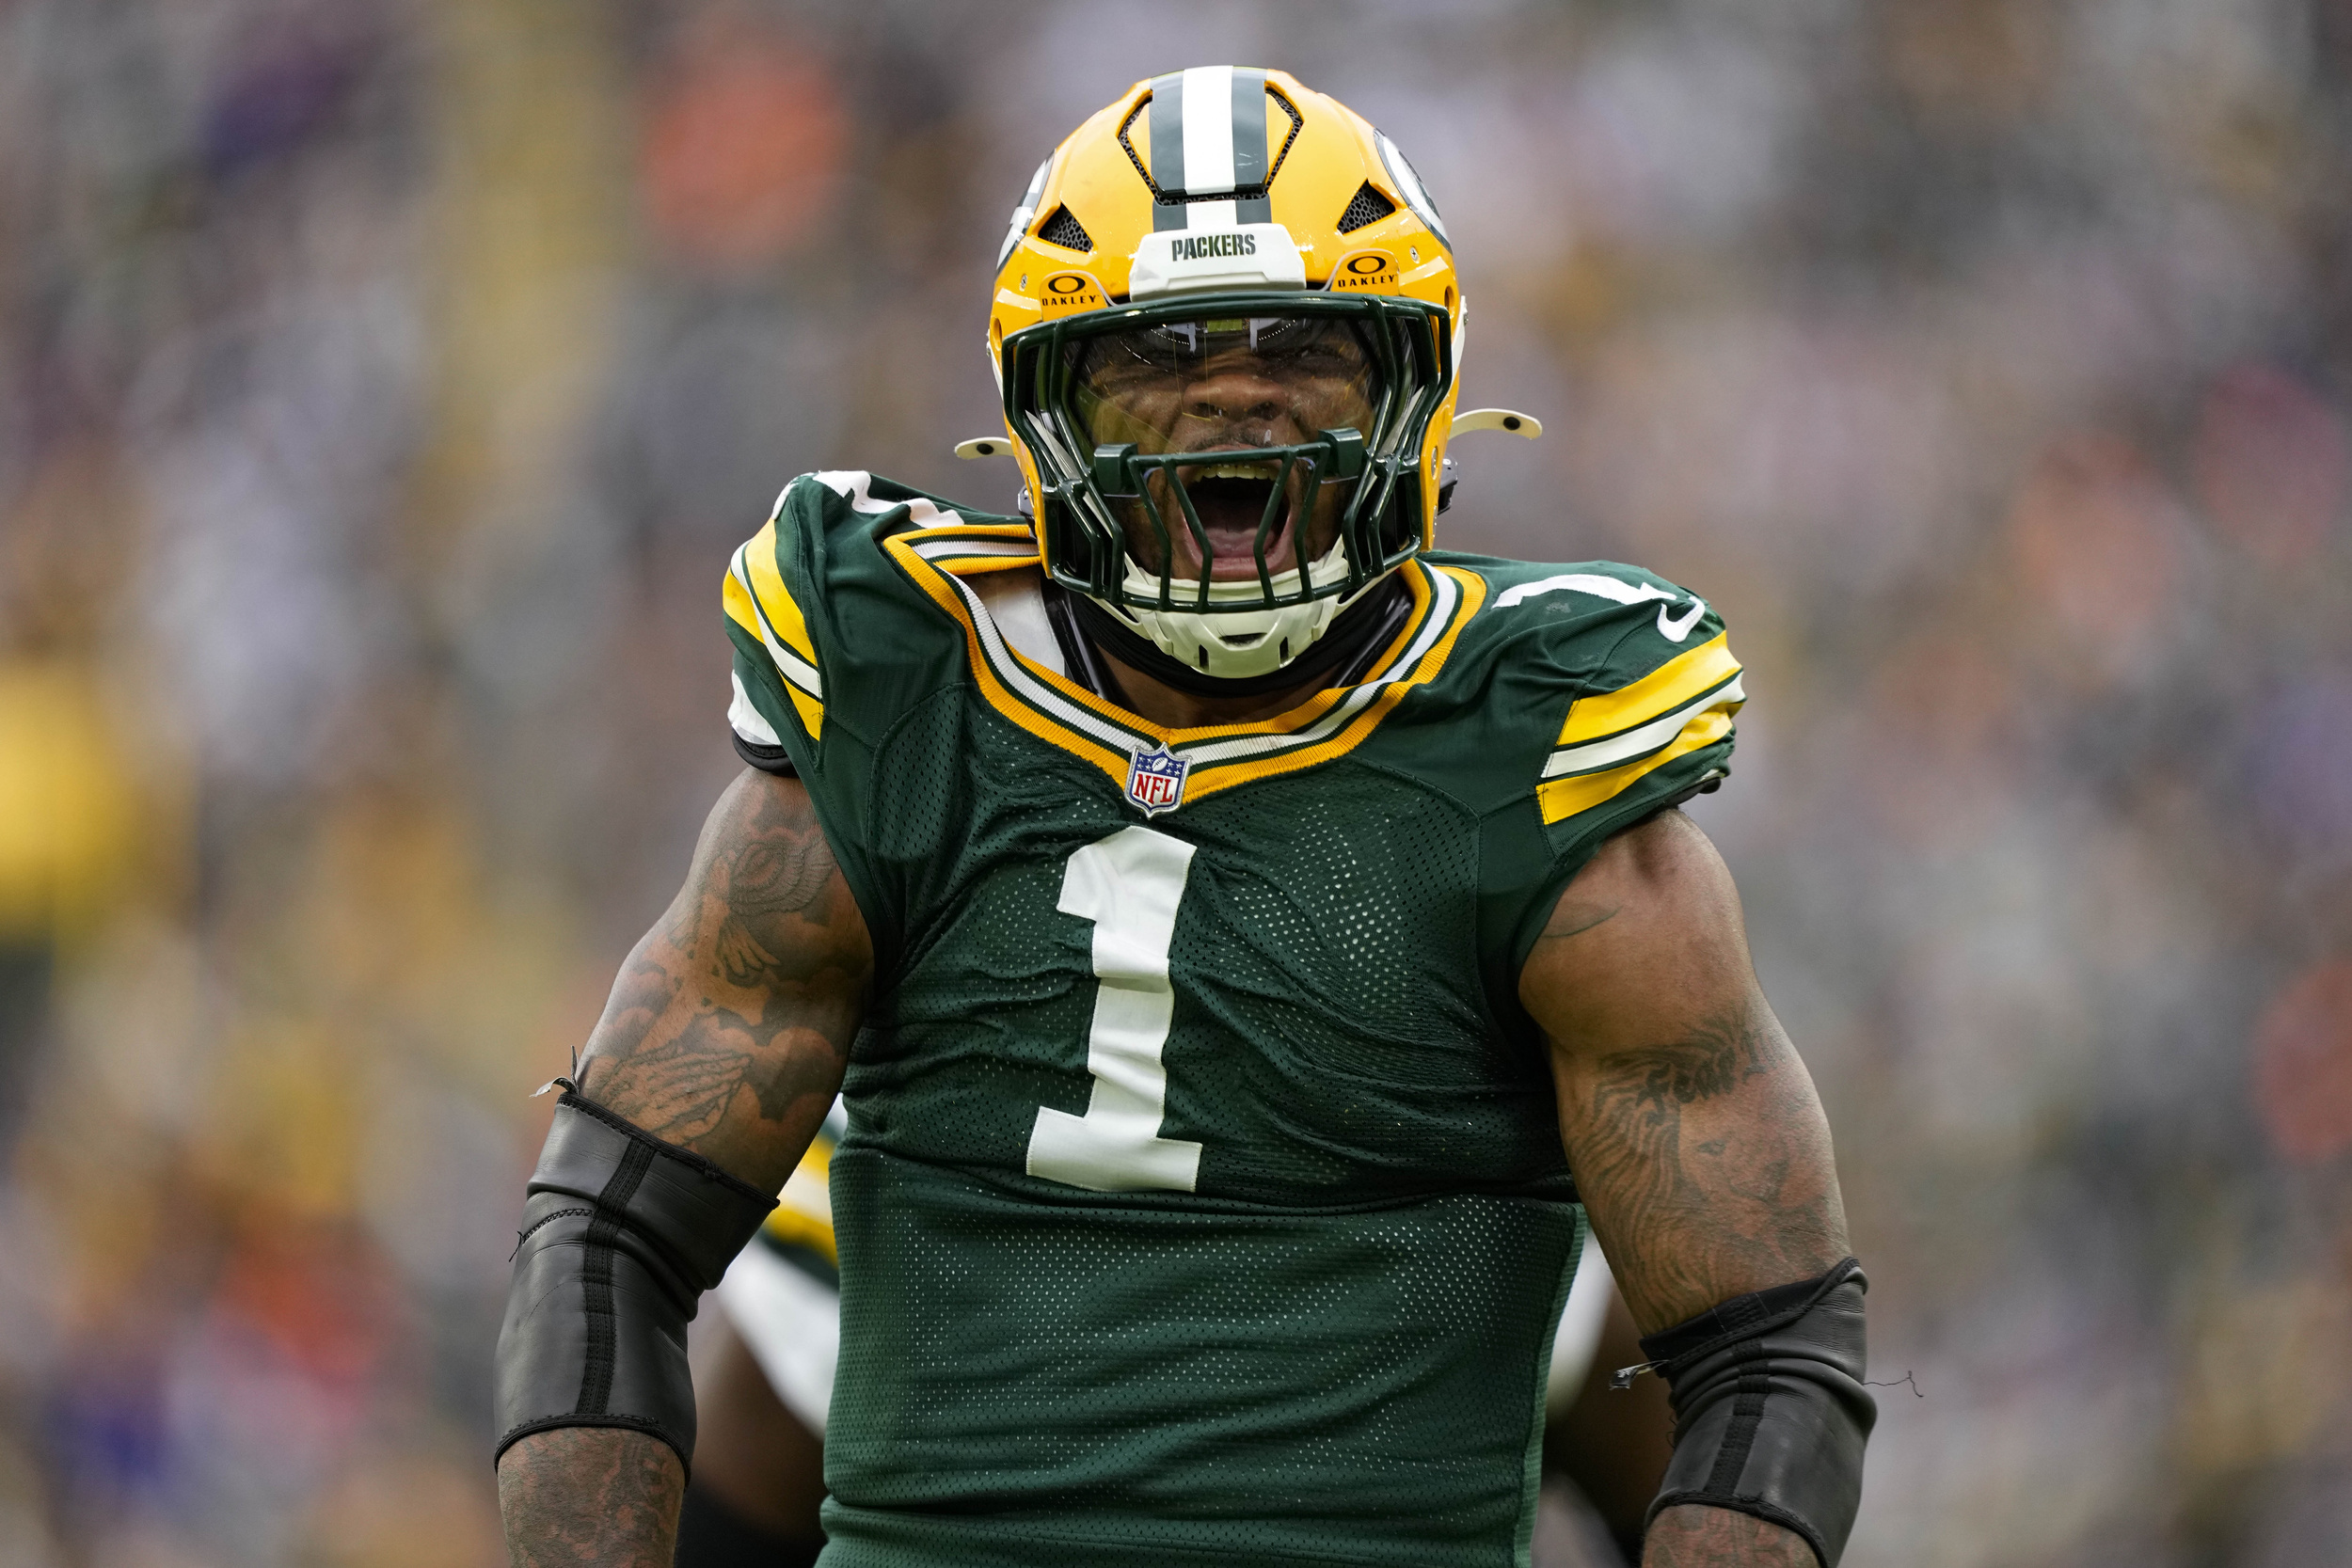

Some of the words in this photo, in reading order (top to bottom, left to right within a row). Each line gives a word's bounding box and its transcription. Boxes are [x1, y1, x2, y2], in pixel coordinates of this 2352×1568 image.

[1171, 233, 1256, 261] PACKERS
[1338, 274, 1395, 288] OAKLEY
[1041, 294, 1097, 307] OAKLEY
[1134, 773, 1173, 805] NFL
[1025, 825, 1202, 1193] 1
